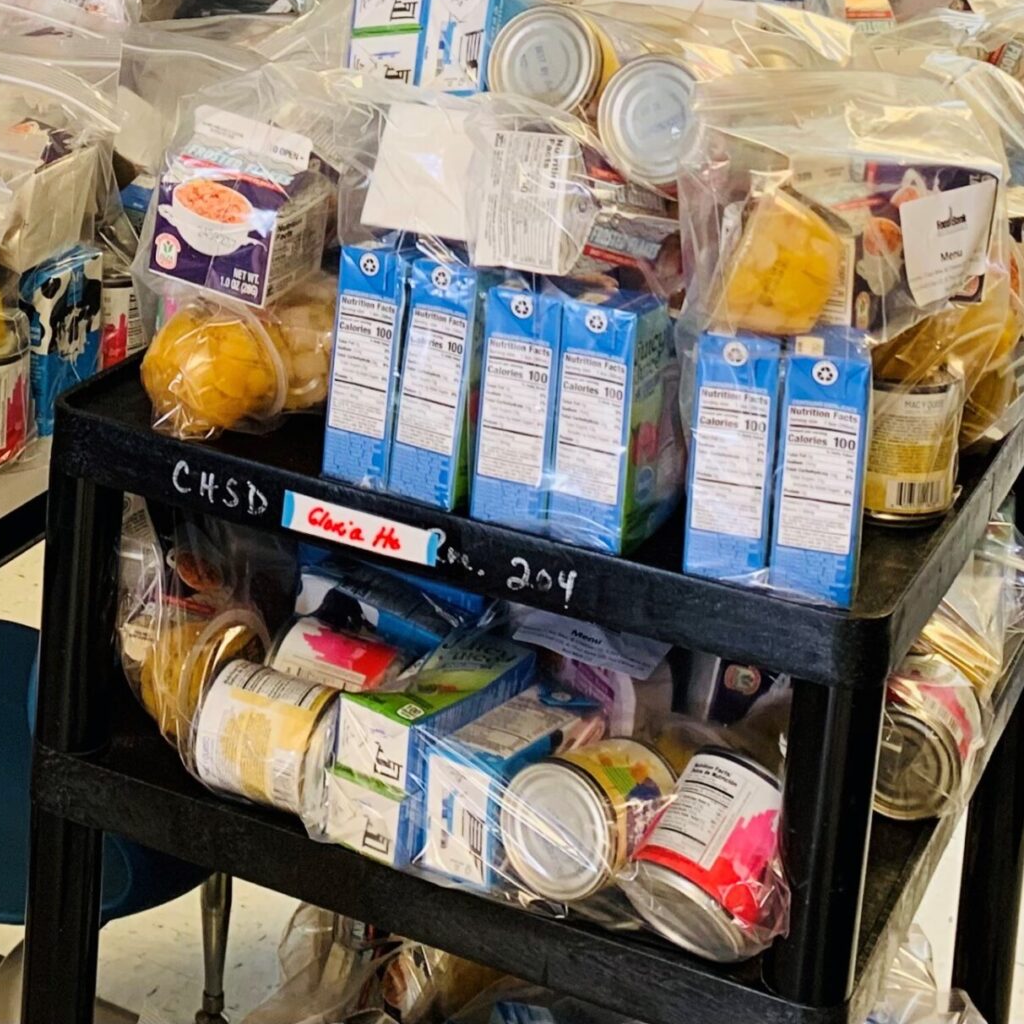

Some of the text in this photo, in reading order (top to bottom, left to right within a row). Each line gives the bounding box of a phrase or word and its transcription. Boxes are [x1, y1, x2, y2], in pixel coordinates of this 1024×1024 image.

[940, 249, 963, 261] Menu
[233, 268, 247, 282] NET
[219, 276, 231, 289] 1.0
[230, 279, 241, 292] OZ
[340, 295, 396, 314] Nutrition Facts
[414, 309, 466, 329] Nutrition Facts
[339, 321, 393, 340] Calories 100
[447, 341, 463, 355] 100
[489, 339, 550, 358] Nutrition Facts
[564, 353, 625, 374] Nutrition Facts
[487, 364, 548, 384] Calories 100
[562, 380, 623, 401] Calories 100
[743, 394, 768, 406] Facts
[789, 407, 858, 424] Nutrition Facts
[699, 416, 766, 433] Calories 100
[787, 434, 856, 451] Calories 100
[171, 459, 269, 516] CHSD
[570, 629, 603, 645] Menu
